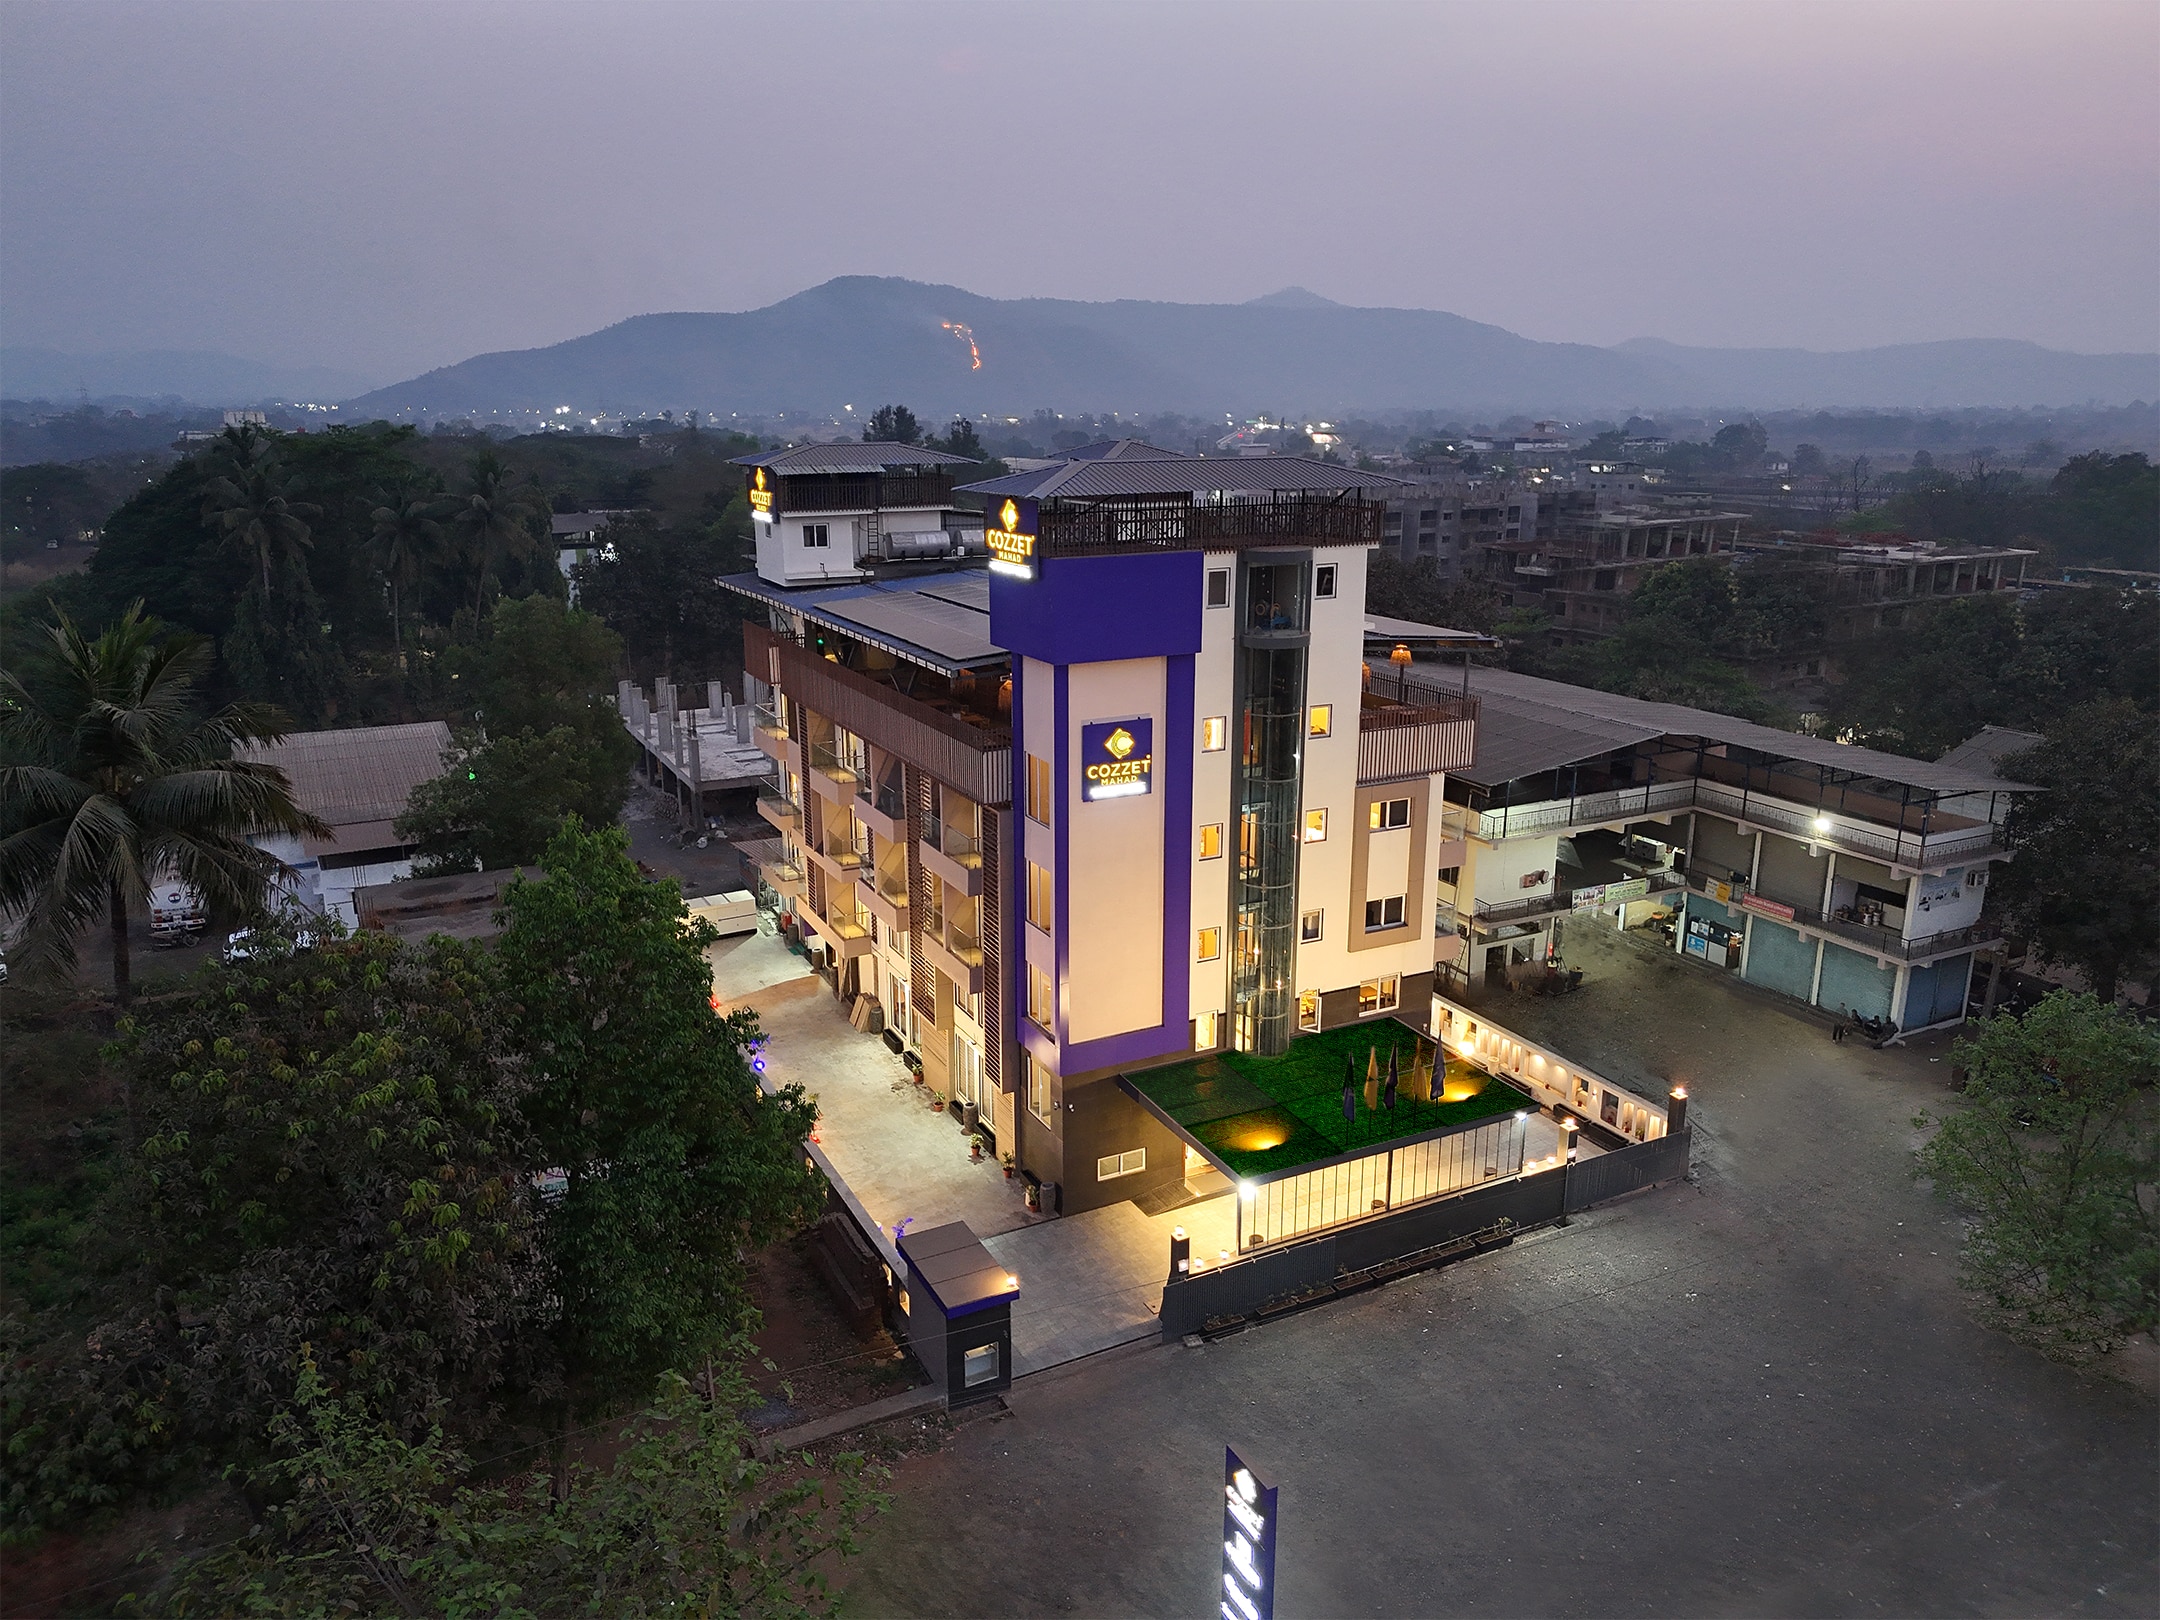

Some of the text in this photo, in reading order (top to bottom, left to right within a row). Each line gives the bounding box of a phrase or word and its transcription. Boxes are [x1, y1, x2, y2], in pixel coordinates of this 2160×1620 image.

[986, 528, 1034, 556] COZZET
[998, 550, 1022, 563] MAHAD
[1086, 759, 1151, 780] COZZET
[1100, 775, 1138, 786] MAHAD
